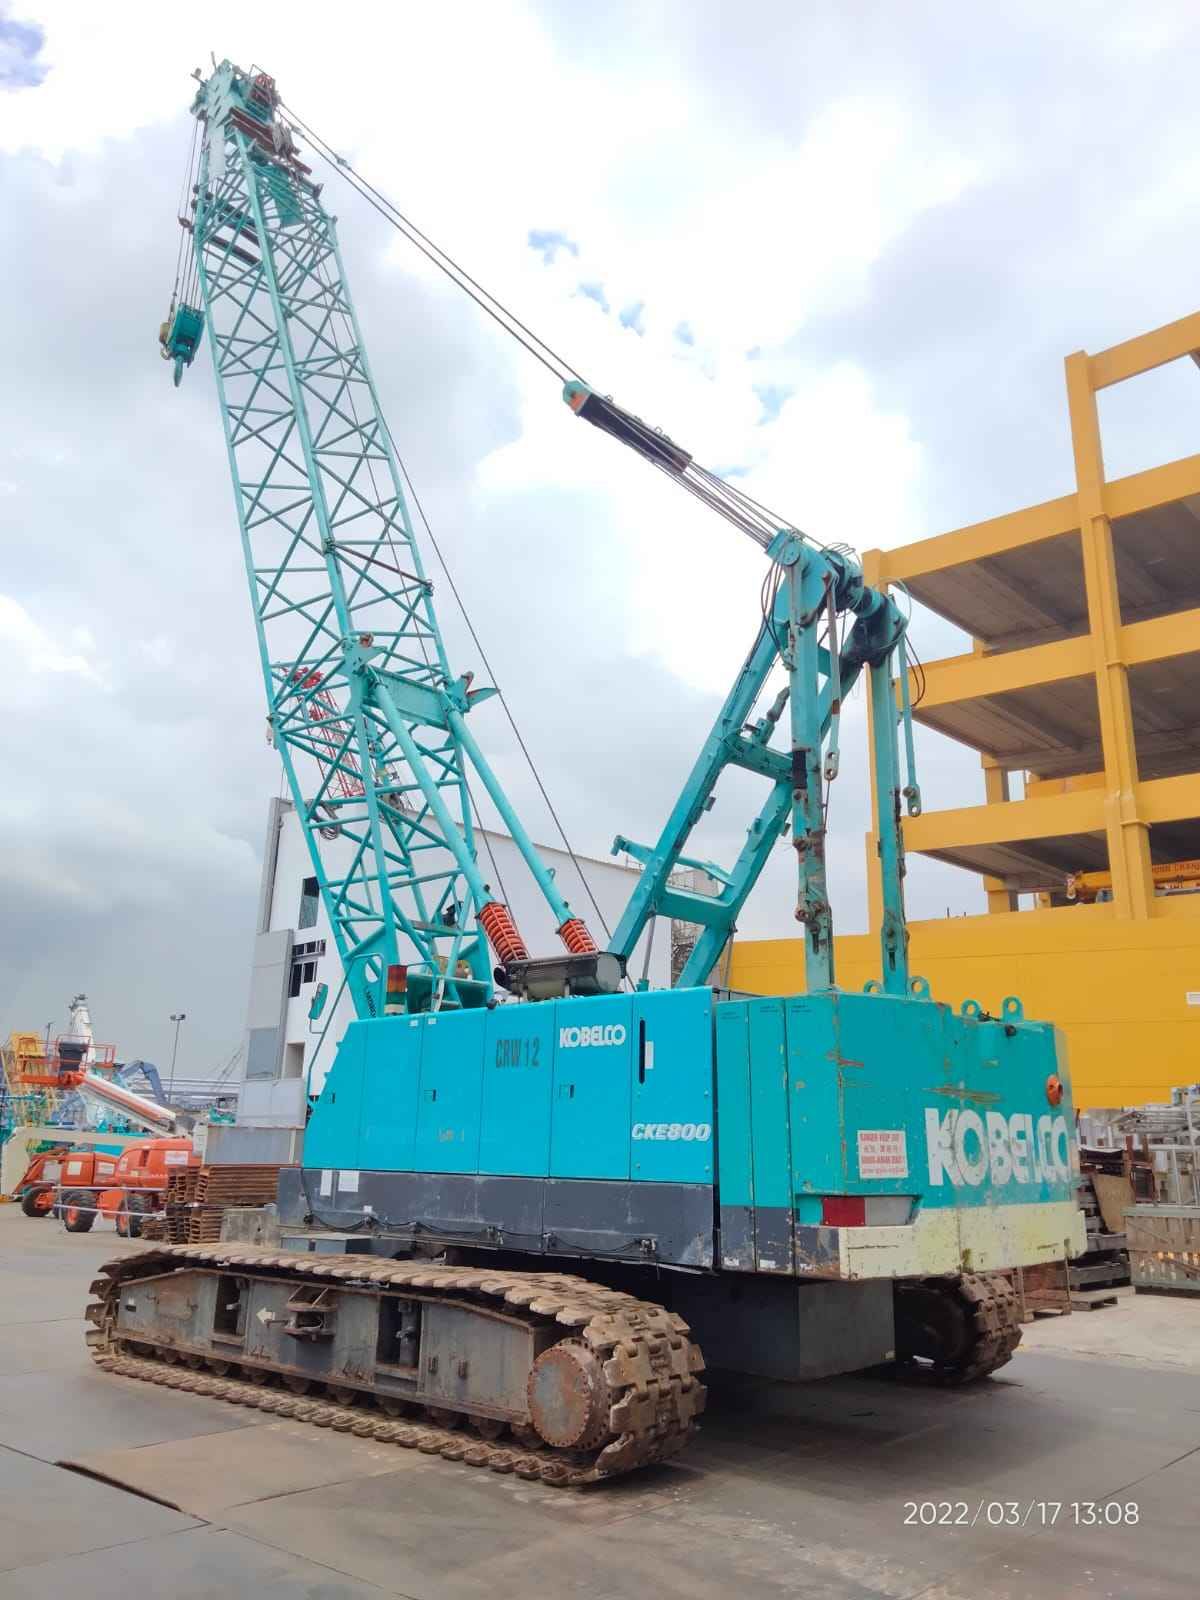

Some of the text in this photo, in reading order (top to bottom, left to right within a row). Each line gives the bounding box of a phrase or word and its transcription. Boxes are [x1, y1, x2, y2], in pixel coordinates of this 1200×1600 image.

[559, 1024, 626, 1048] KOBELCO
[631, 1123, 711, 1141] CKE800
[924, 1107, 1072, 1187] KOBELCO
